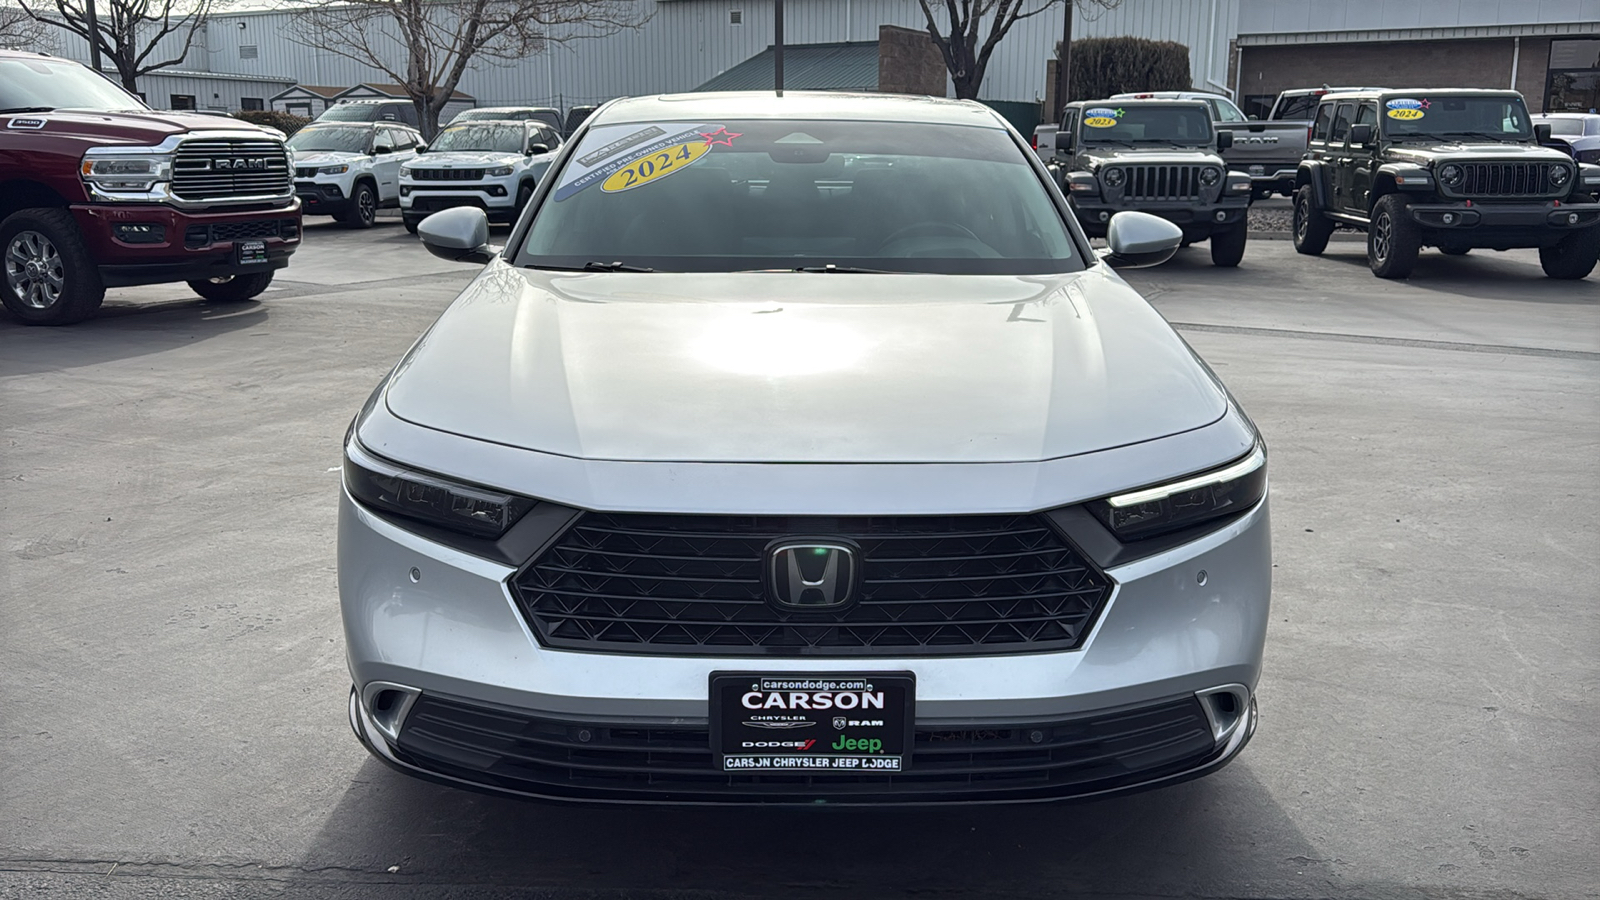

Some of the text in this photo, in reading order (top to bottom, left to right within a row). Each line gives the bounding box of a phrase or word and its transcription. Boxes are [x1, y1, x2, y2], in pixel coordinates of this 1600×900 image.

[215, 159, 263, 168] RAM
[574, 163, 616, 187] CERTIFIED
[616, 142, 666, 166] PRE-OWNED
[665, 130, 699, 145] VEHICLE
[620, 144, 692, 188] 2024
[763, 680, 864, 691] carsondodge.com
[741, 691, 884, 709] CARSON
[832, 734, 882, 754] Jeep
[773, 757, 830, 768] CHRYSLER
[832, 758, 860, 768] JEEP
